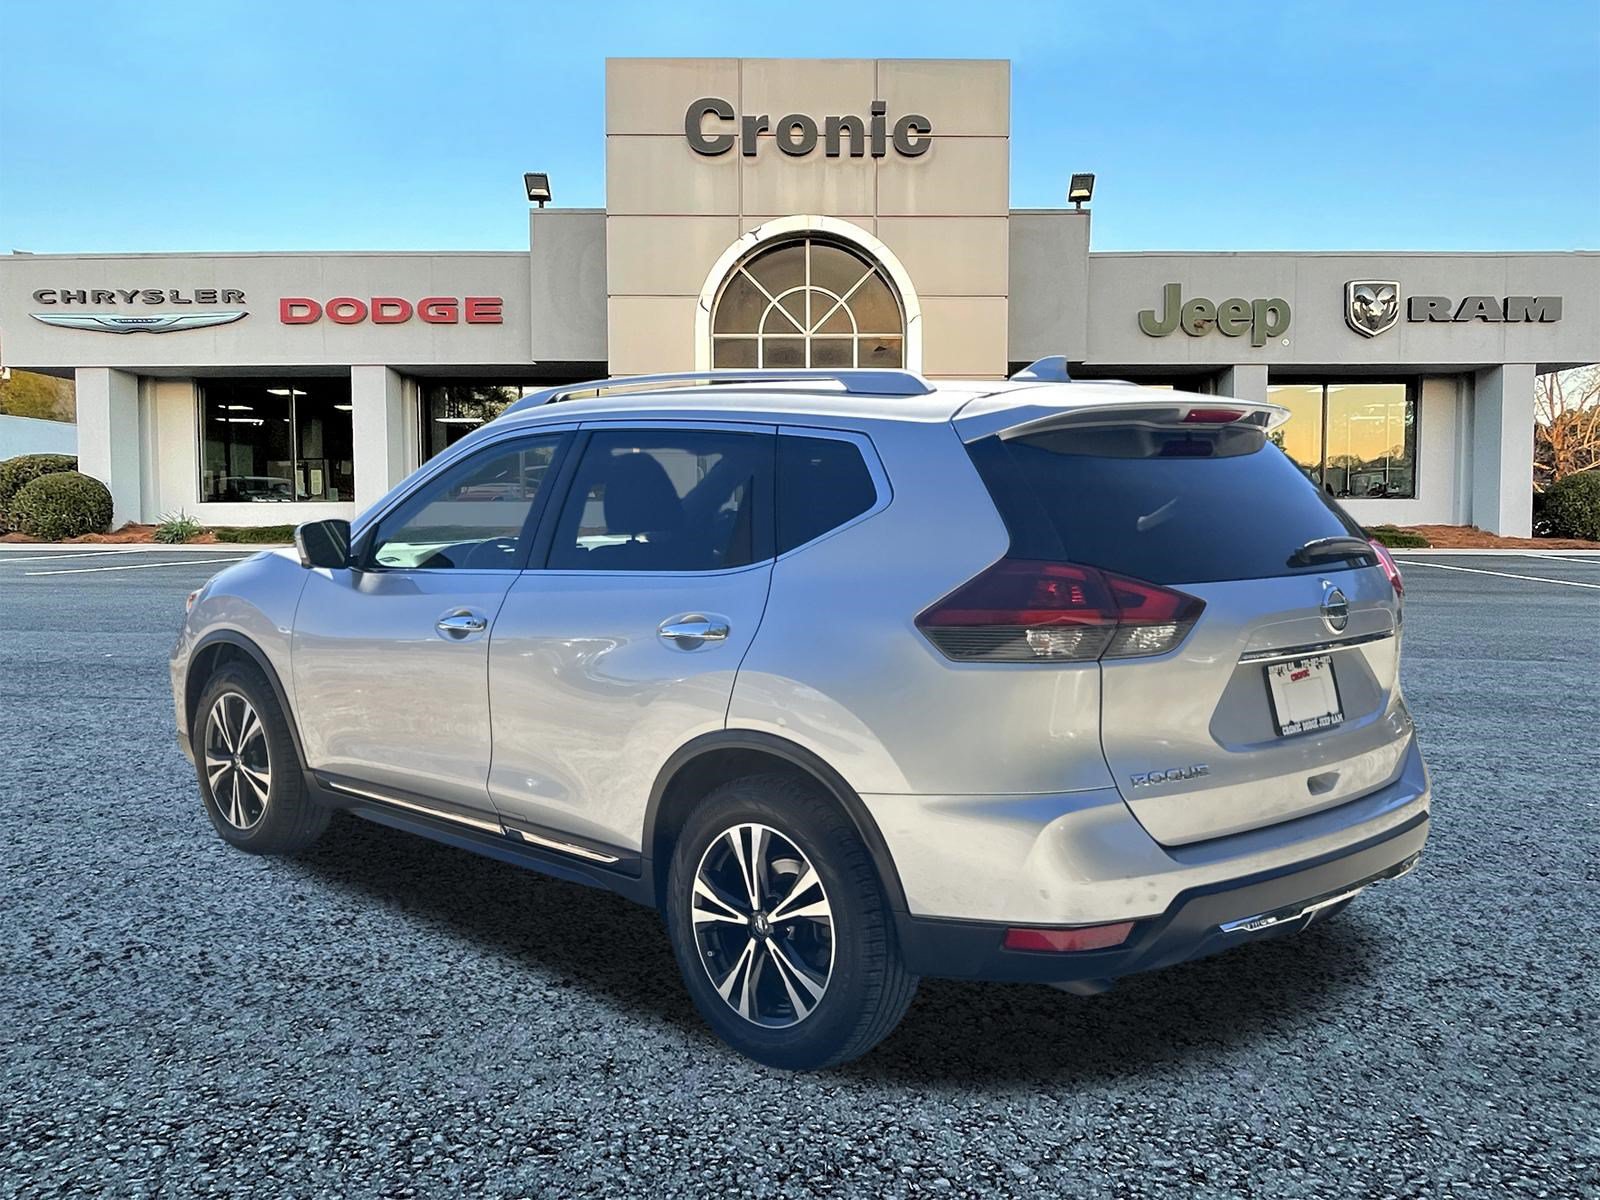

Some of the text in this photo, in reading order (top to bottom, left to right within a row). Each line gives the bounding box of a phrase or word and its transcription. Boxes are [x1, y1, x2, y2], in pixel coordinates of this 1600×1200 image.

[685, 97, 932, 158] Cronic
[32, 289, 246, 304] CHRYSLER
[1407, 296, 1563, 322] RAM
[279, 296, 503, 325] DODGE
[1138, 283, 1291, 347] Jeep
[1130, 764, 1210, 788] ROGUE
